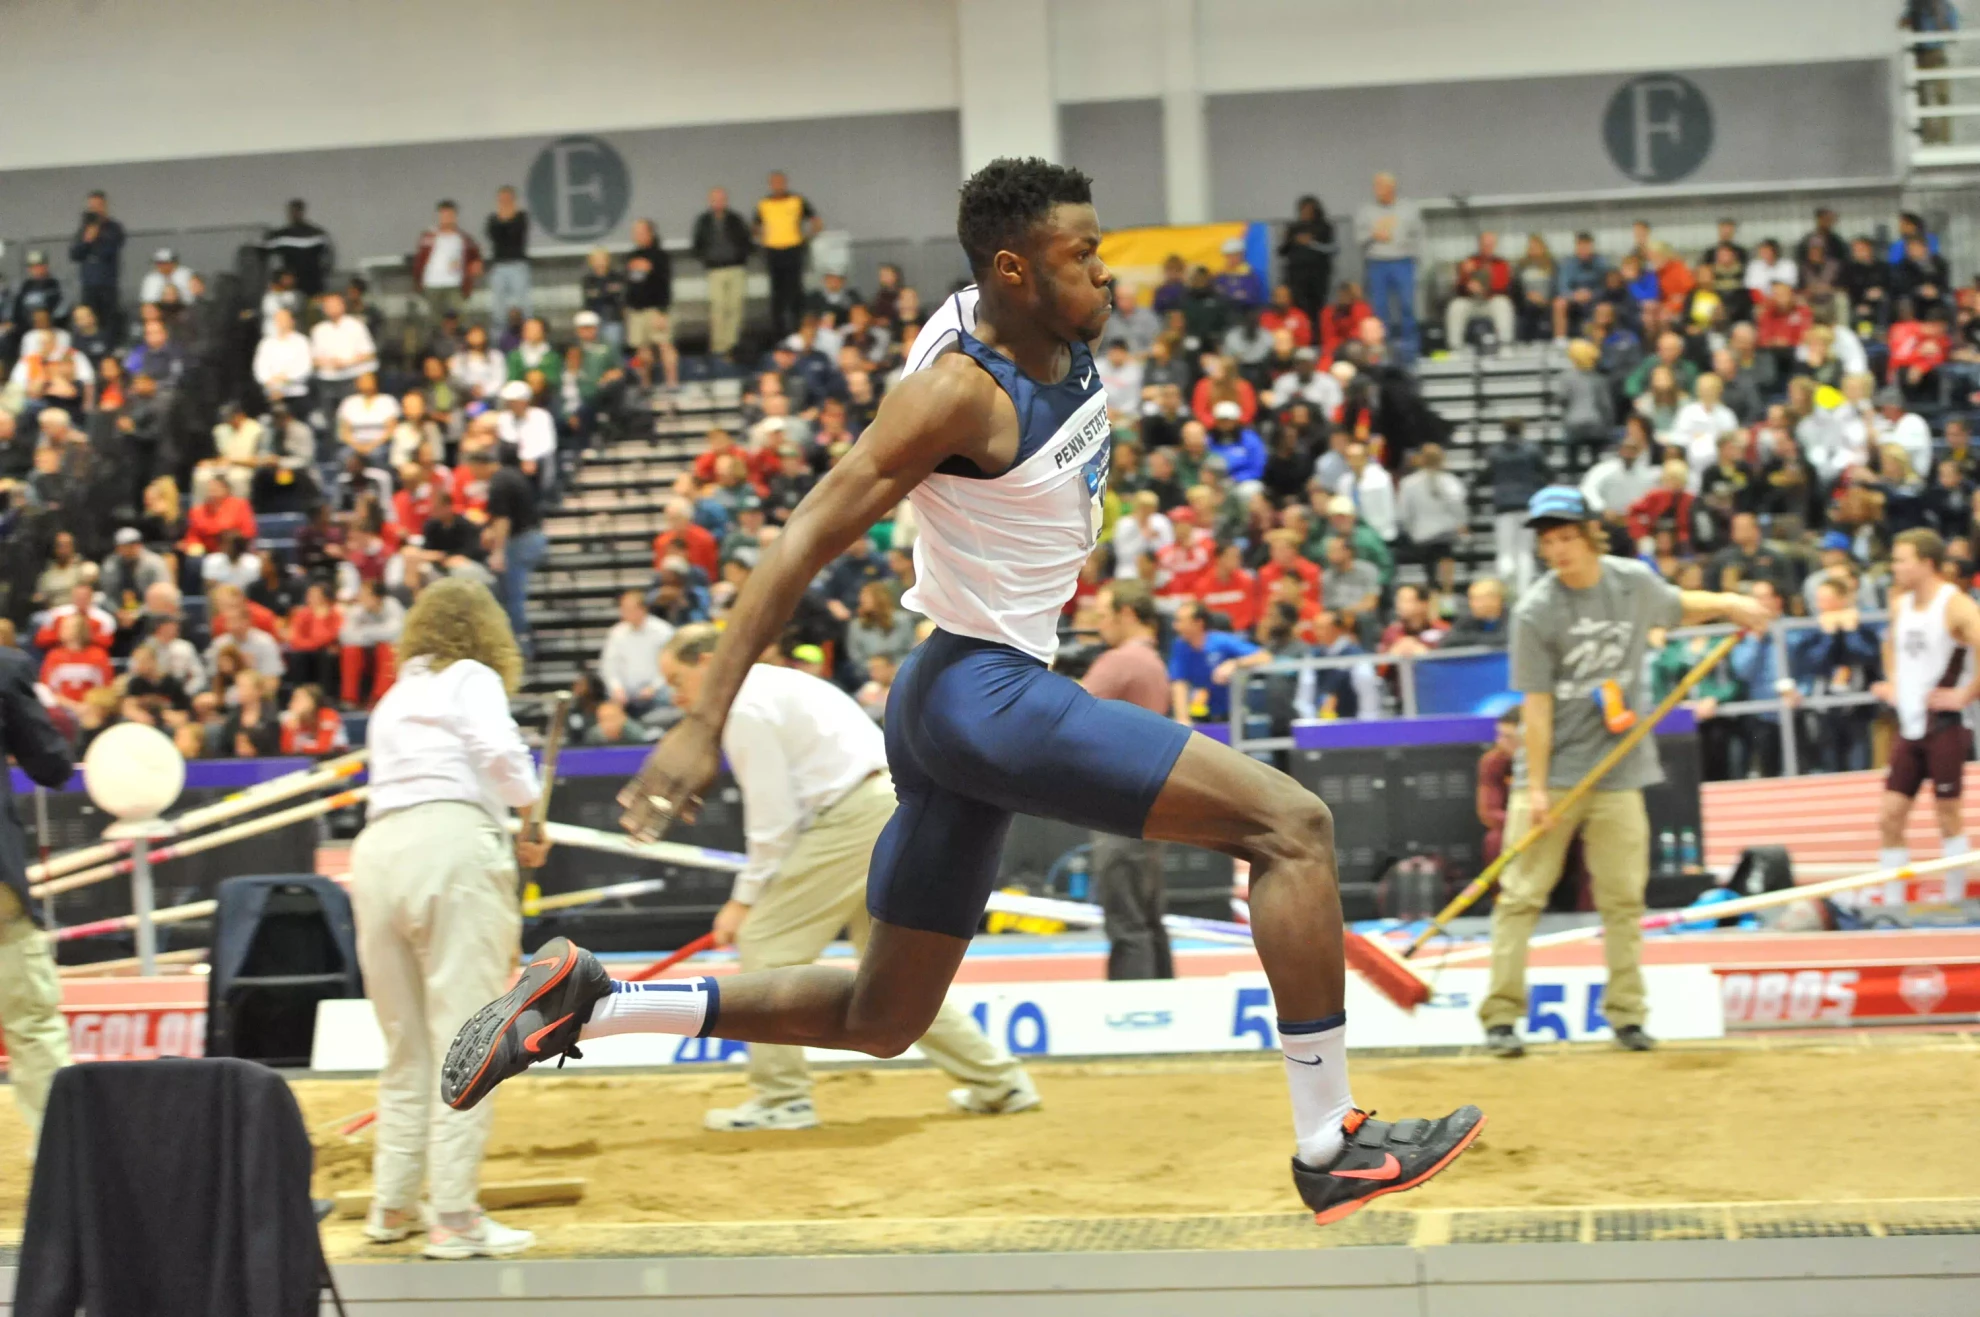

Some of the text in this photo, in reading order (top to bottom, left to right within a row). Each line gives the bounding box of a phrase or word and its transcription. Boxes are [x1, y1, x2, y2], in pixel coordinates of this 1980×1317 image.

[1631, 82, 1687, 177] F
[553, 142, 607, 236] E
[1054, 432, 1086, 470] PENN
[1722, 970, 1859, 1022] OBOS
